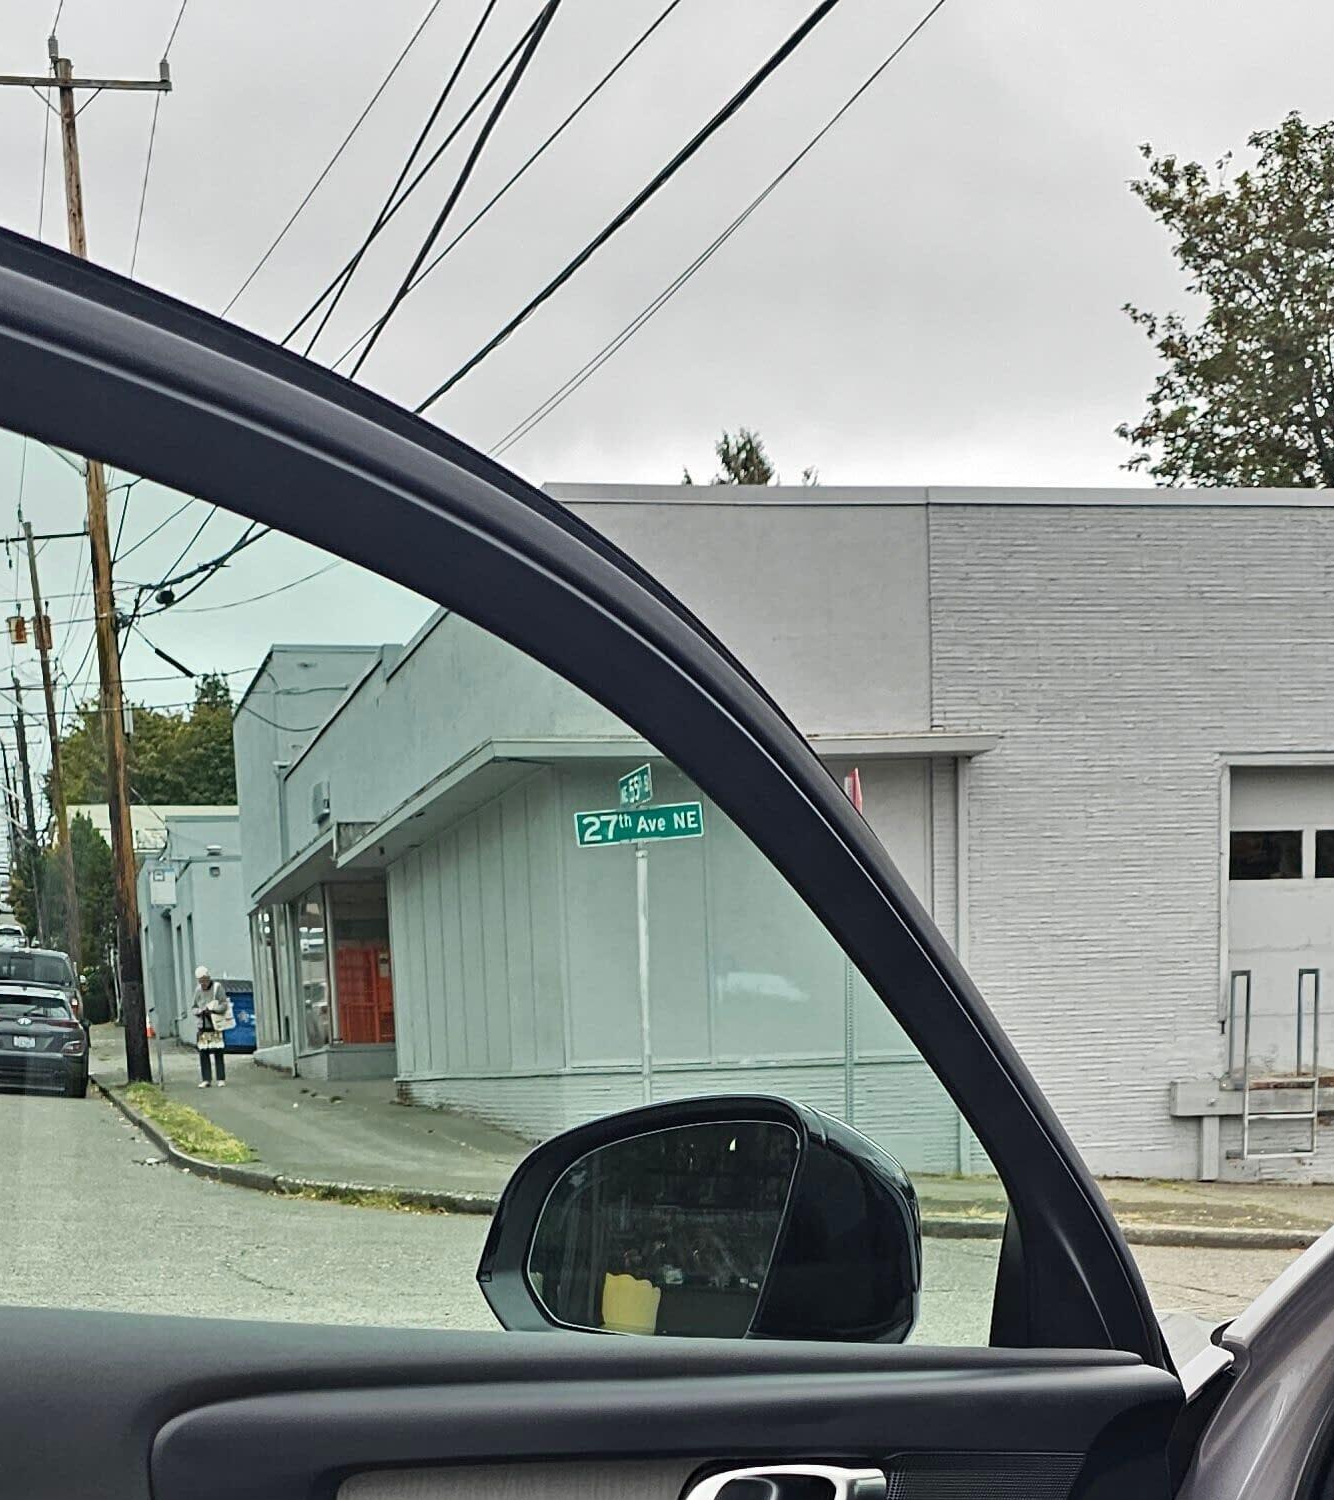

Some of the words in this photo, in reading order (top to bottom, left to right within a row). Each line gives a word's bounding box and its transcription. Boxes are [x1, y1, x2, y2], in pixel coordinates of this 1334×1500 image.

[582, 813, 633, 842] 27th
[636, 815, 666, 834] Ave
[673, 811, 699, 830] NE
